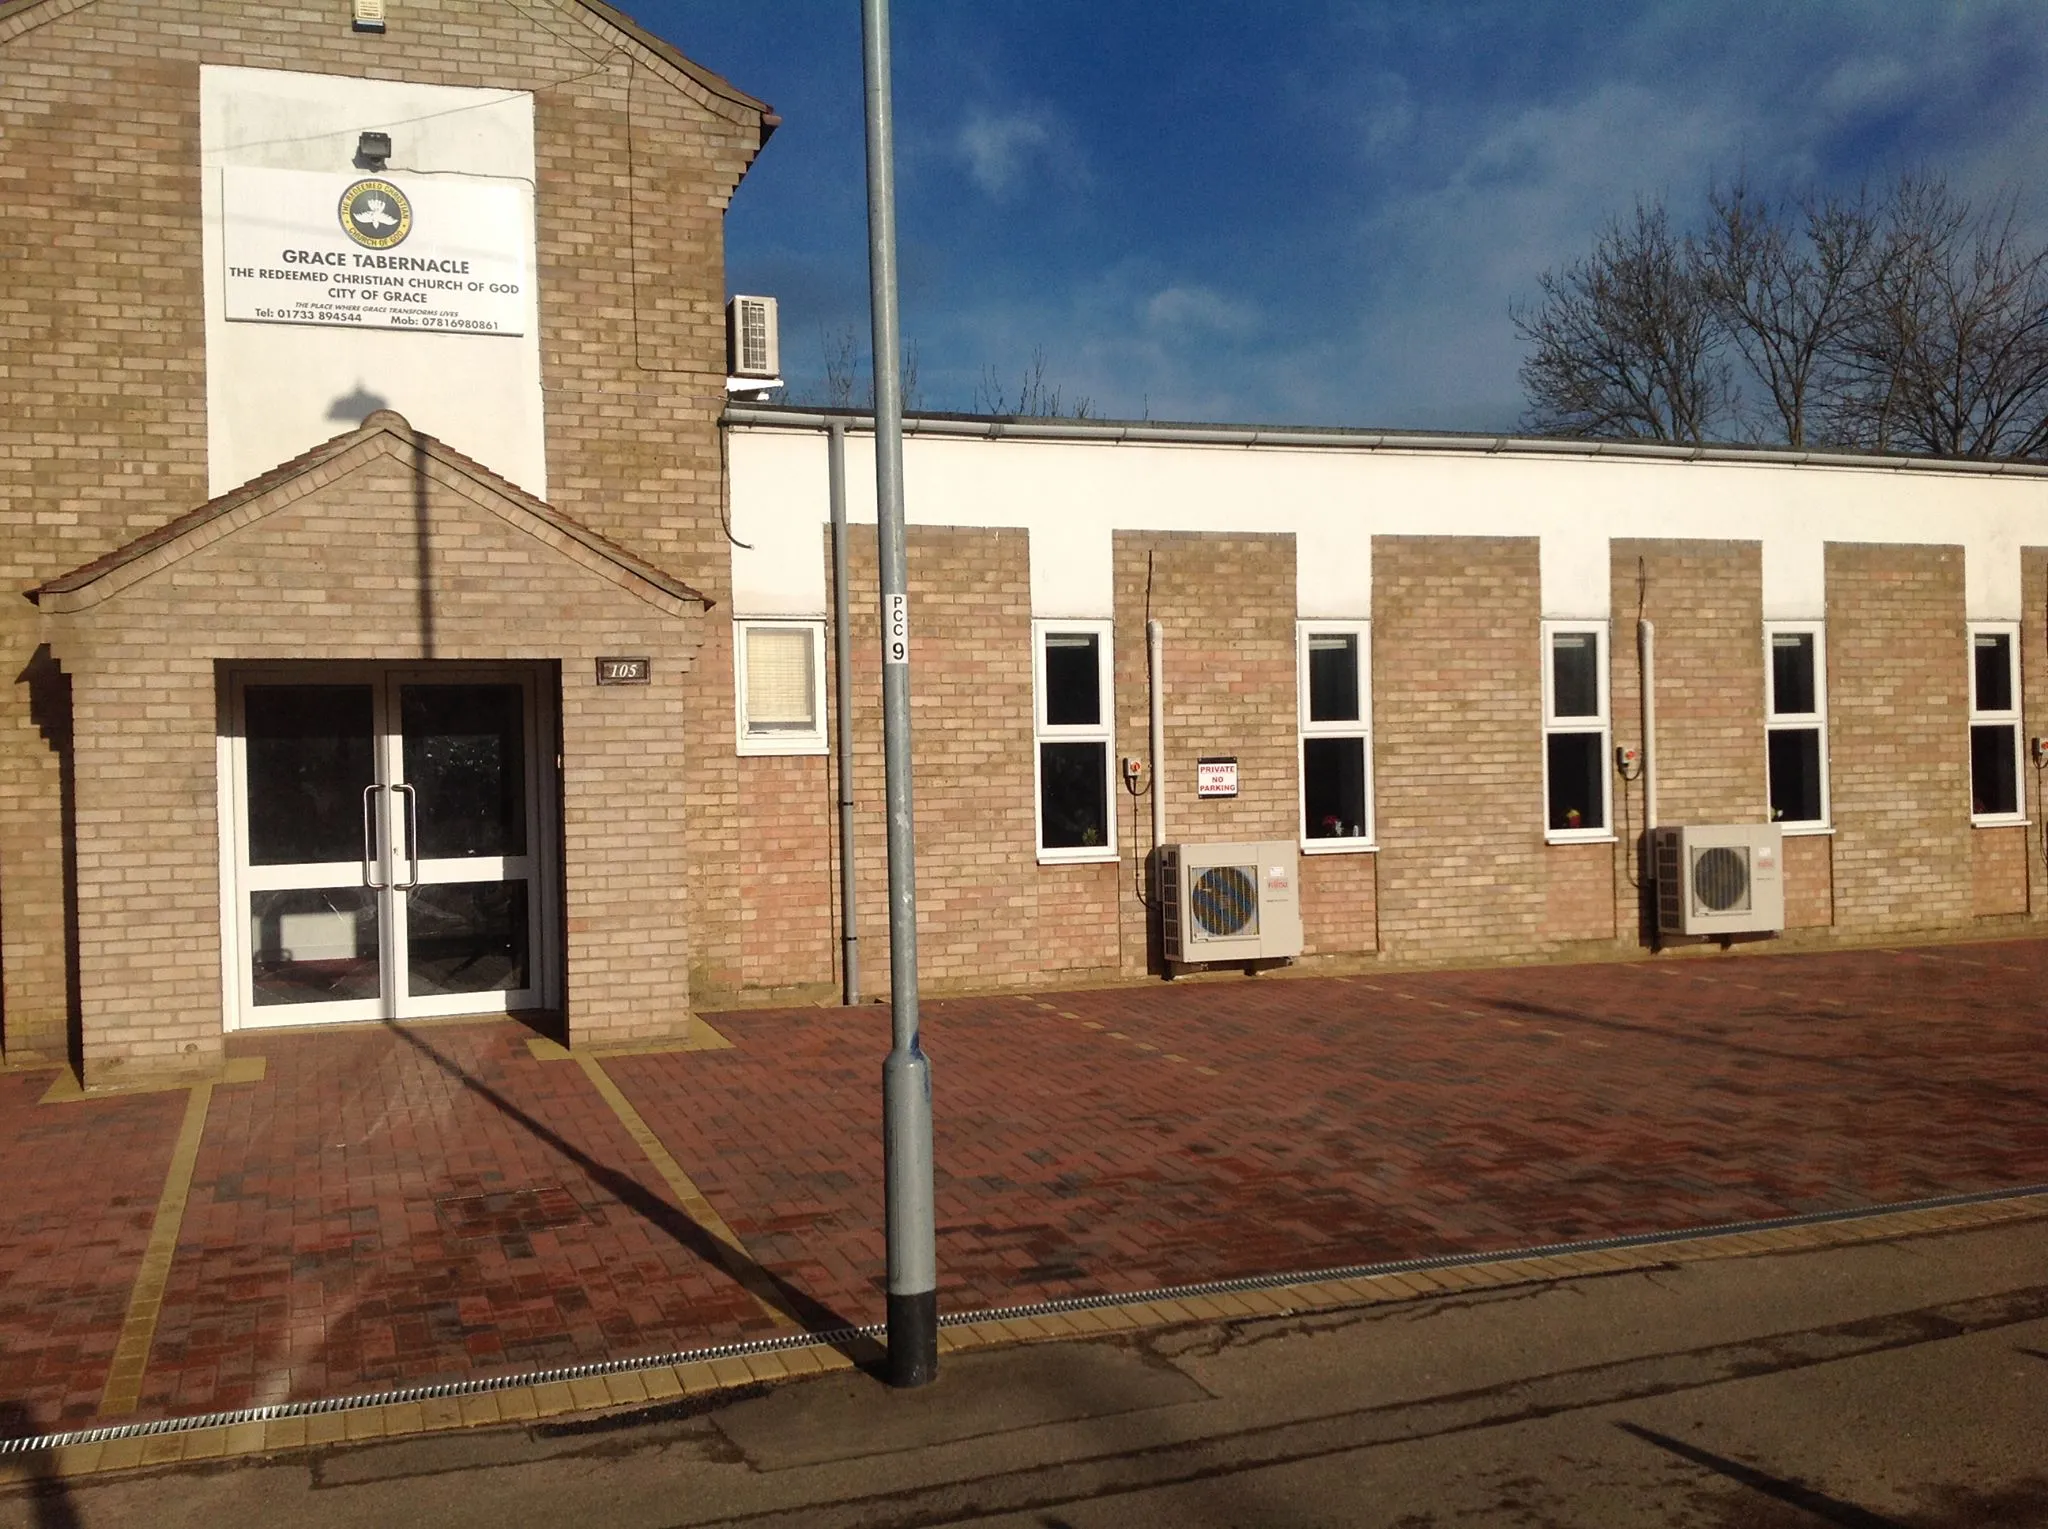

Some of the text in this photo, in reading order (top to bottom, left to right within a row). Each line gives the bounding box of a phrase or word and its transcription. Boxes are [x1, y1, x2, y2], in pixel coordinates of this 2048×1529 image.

[349, 228, 377, 246] CHURCH
[390, 230, 404, 243] GOD
[282, 249, 470, 274] GRACE TABERNACLE
[229, 267, 519, 294] THE REDEEMED CHRISTIAN CHURCH OF GOD
[328, 288, 428, 303] CITY OF GRACE
[255, 308, 362, 322] Tel: 01733 894544
[310, 302, 333, 310] PLACE
[335, 304, 360, 312] WHERE
[389, 307, 438, 316] TRANSFORMS
[390, 316, 498, 330] Mob: 07816980861
[893, 643, 904, 660] 9
[611, 664, 637, 677] 105
[1200, 784, 1236, 792] PARKING
